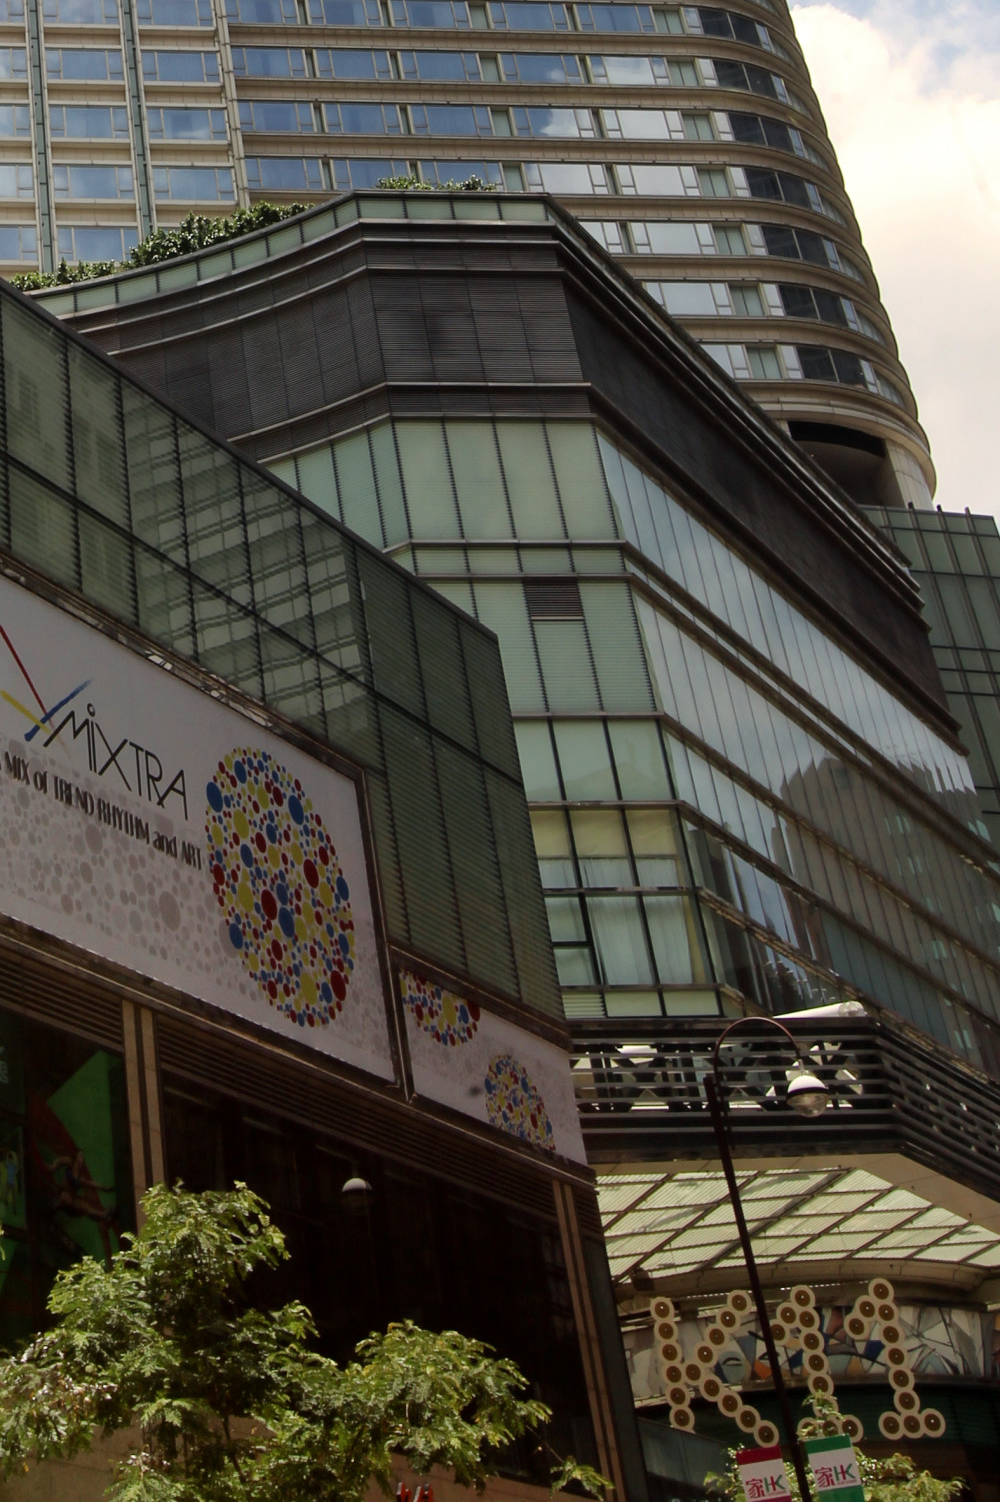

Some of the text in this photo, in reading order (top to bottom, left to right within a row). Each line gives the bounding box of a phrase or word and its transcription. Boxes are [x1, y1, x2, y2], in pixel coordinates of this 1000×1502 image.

[5, 751, 30, 786] MIX
[33, 769, 47, 795] of
[53, 776, 94, 817] TREND
[97, 797, 150, 845] RHYTHM
[152, 831, 178, 859] and
[181, 841, 203, 871] ART
[650, 1278, 946, 1447] K11
